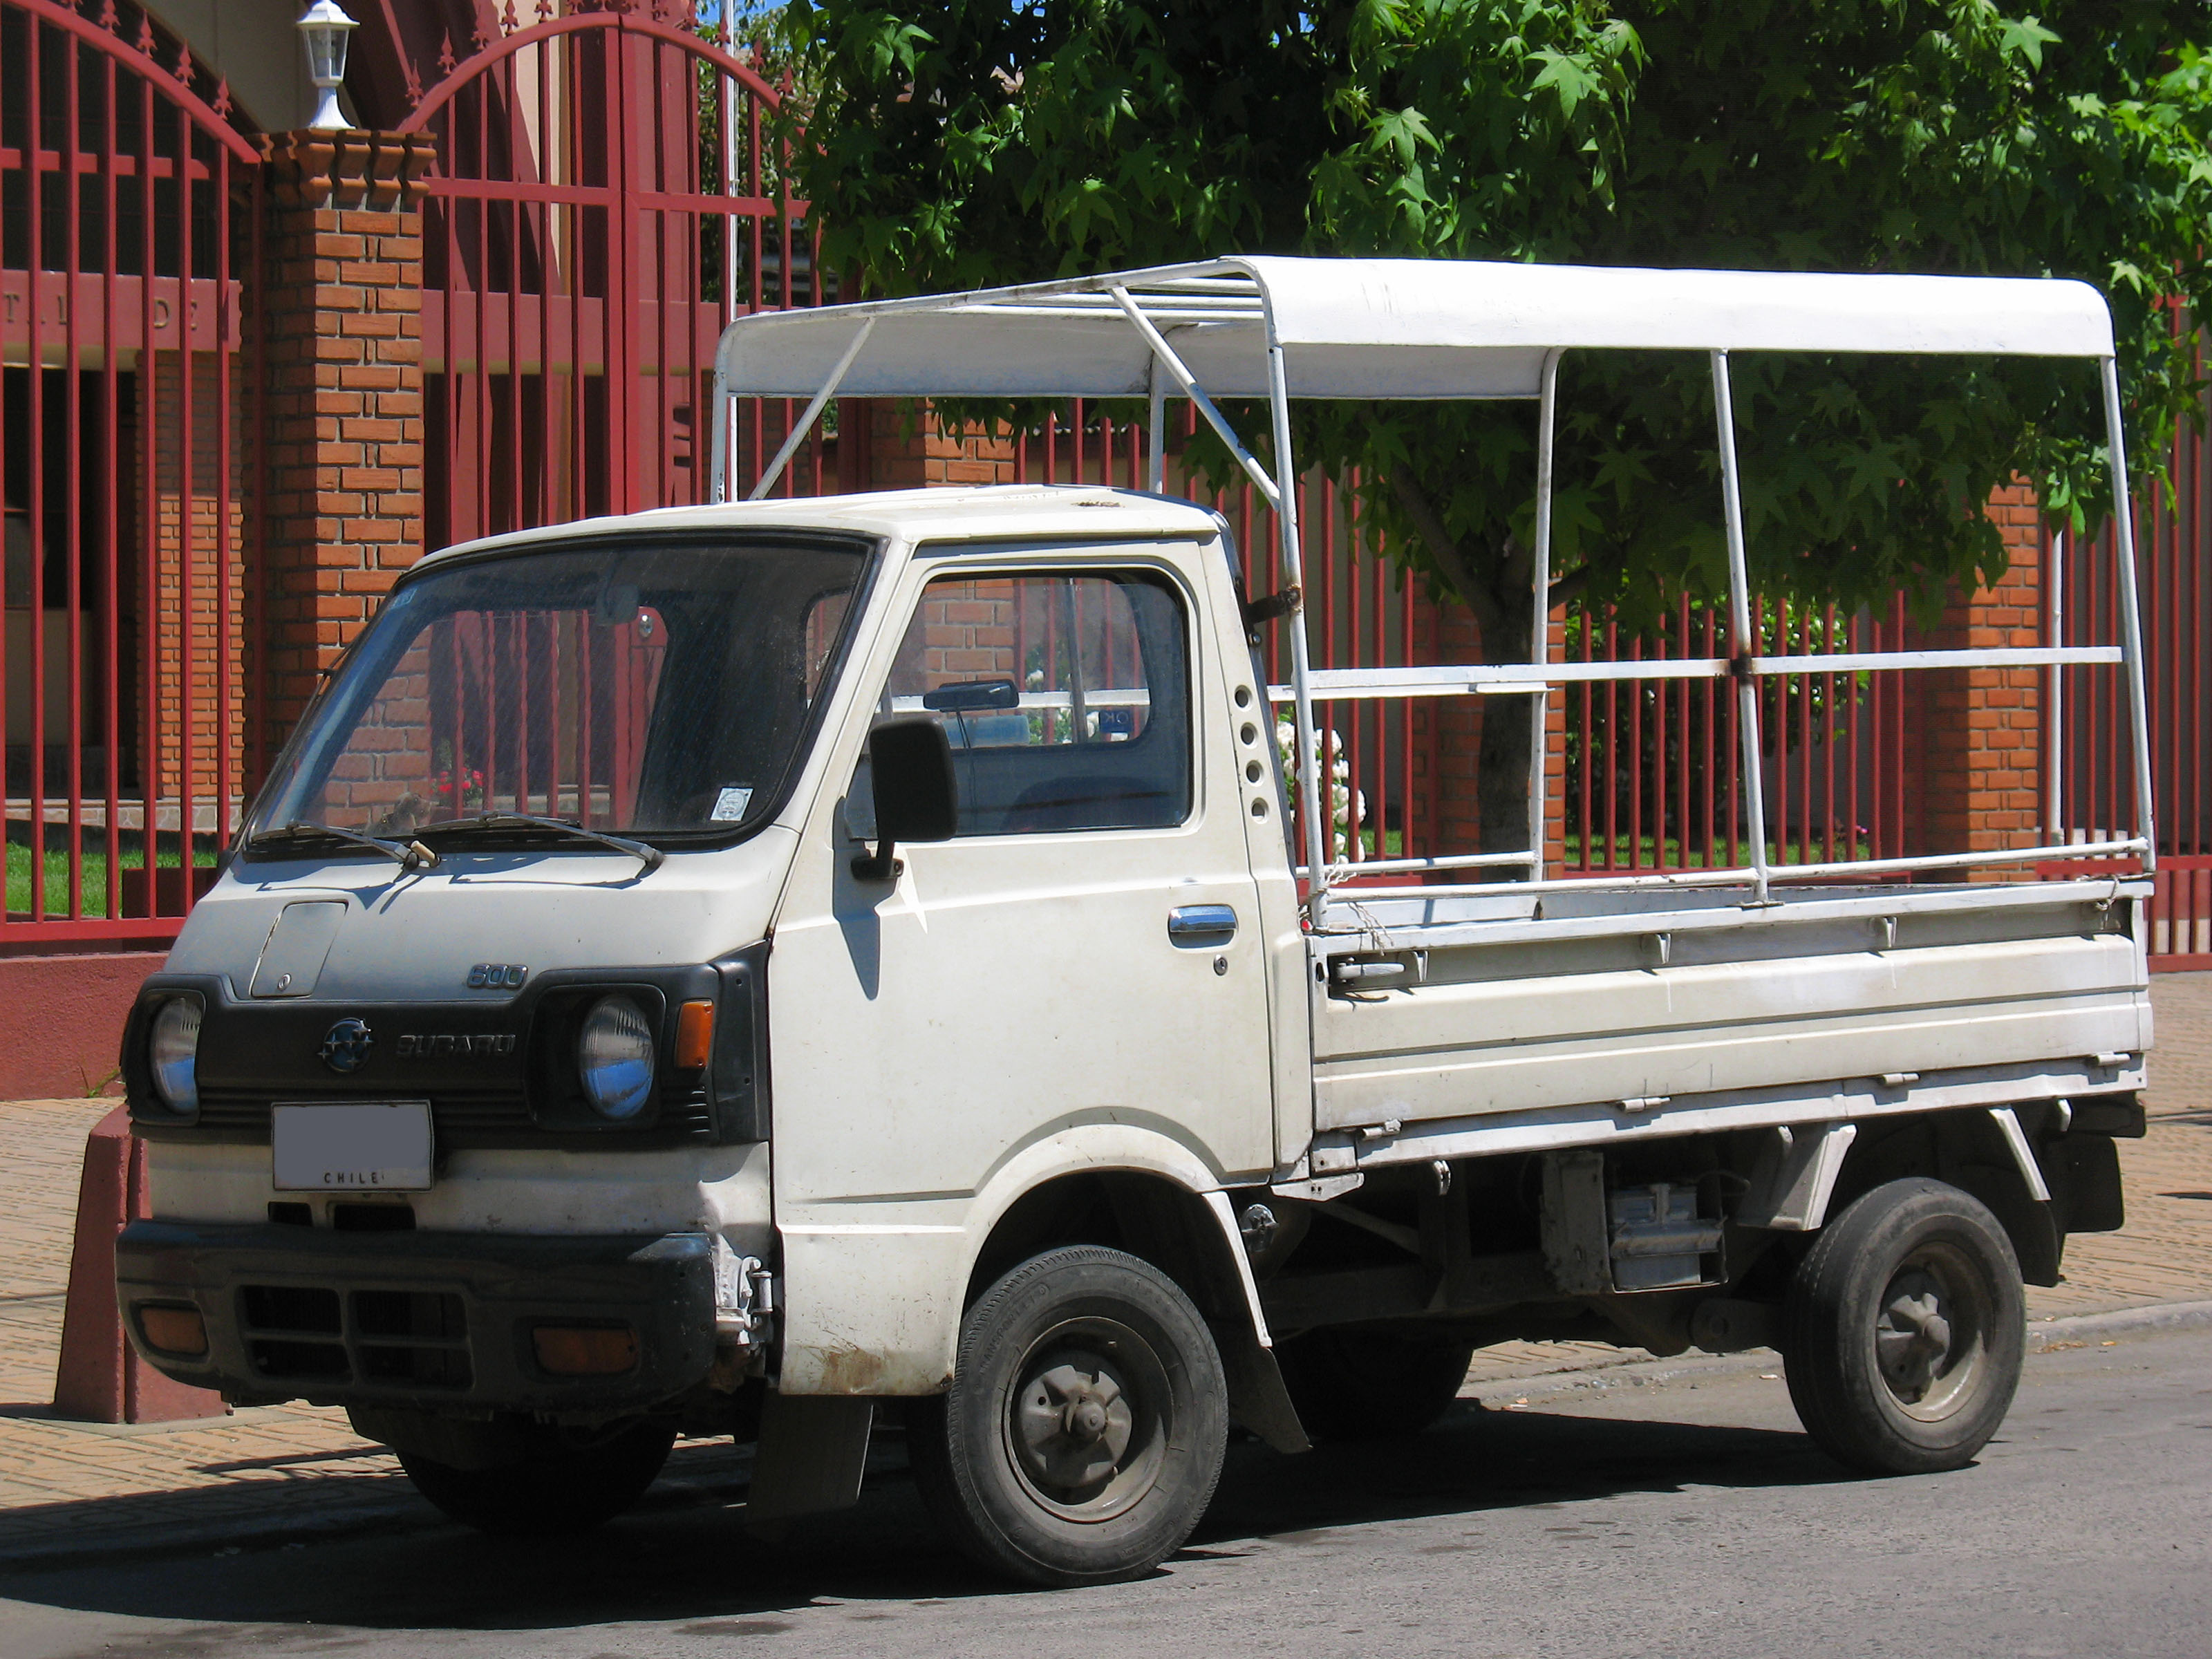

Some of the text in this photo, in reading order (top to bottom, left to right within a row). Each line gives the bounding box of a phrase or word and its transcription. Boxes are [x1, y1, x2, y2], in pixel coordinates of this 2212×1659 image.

[467, 963, 528, 989] 600
[396, 1034, 516, 1055] SUBARU
[324, 1172, 378, 1183] CHILE
